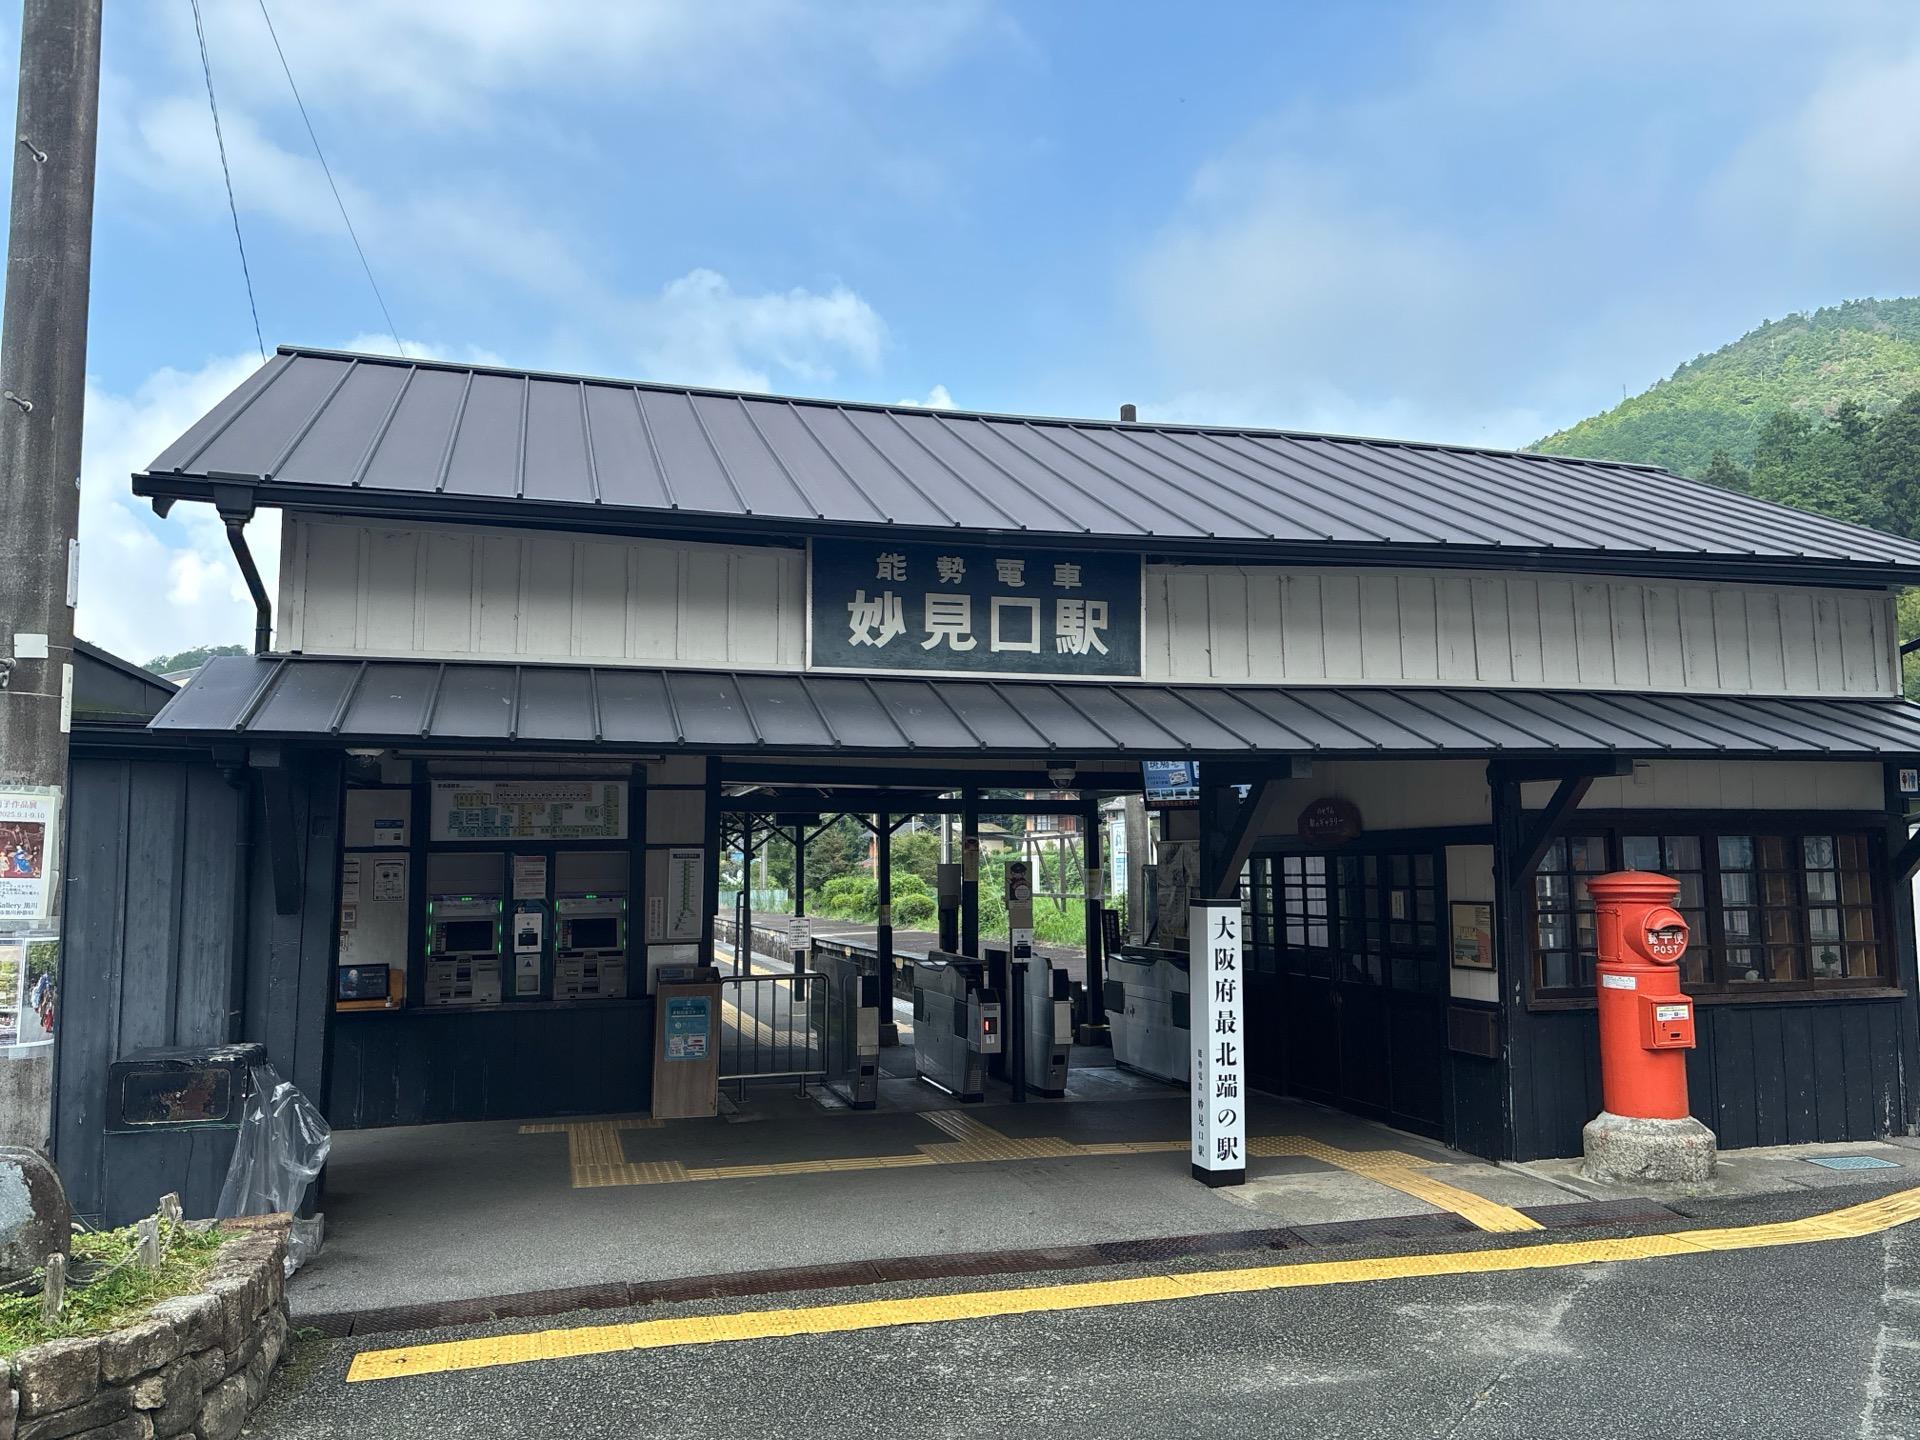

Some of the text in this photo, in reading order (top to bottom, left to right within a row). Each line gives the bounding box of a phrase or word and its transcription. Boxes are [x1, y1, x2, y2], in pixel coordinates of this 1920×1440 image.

[876, 552, 1083, 590] 能勢電車
[847, 589, 1110, 656] 妙見口駅
[0, 799, 37, 810] 子作品展
[1653, 945, 1679, 954] POST
[1213, 915, 1239, 1161] 大阪府最北端の駅
